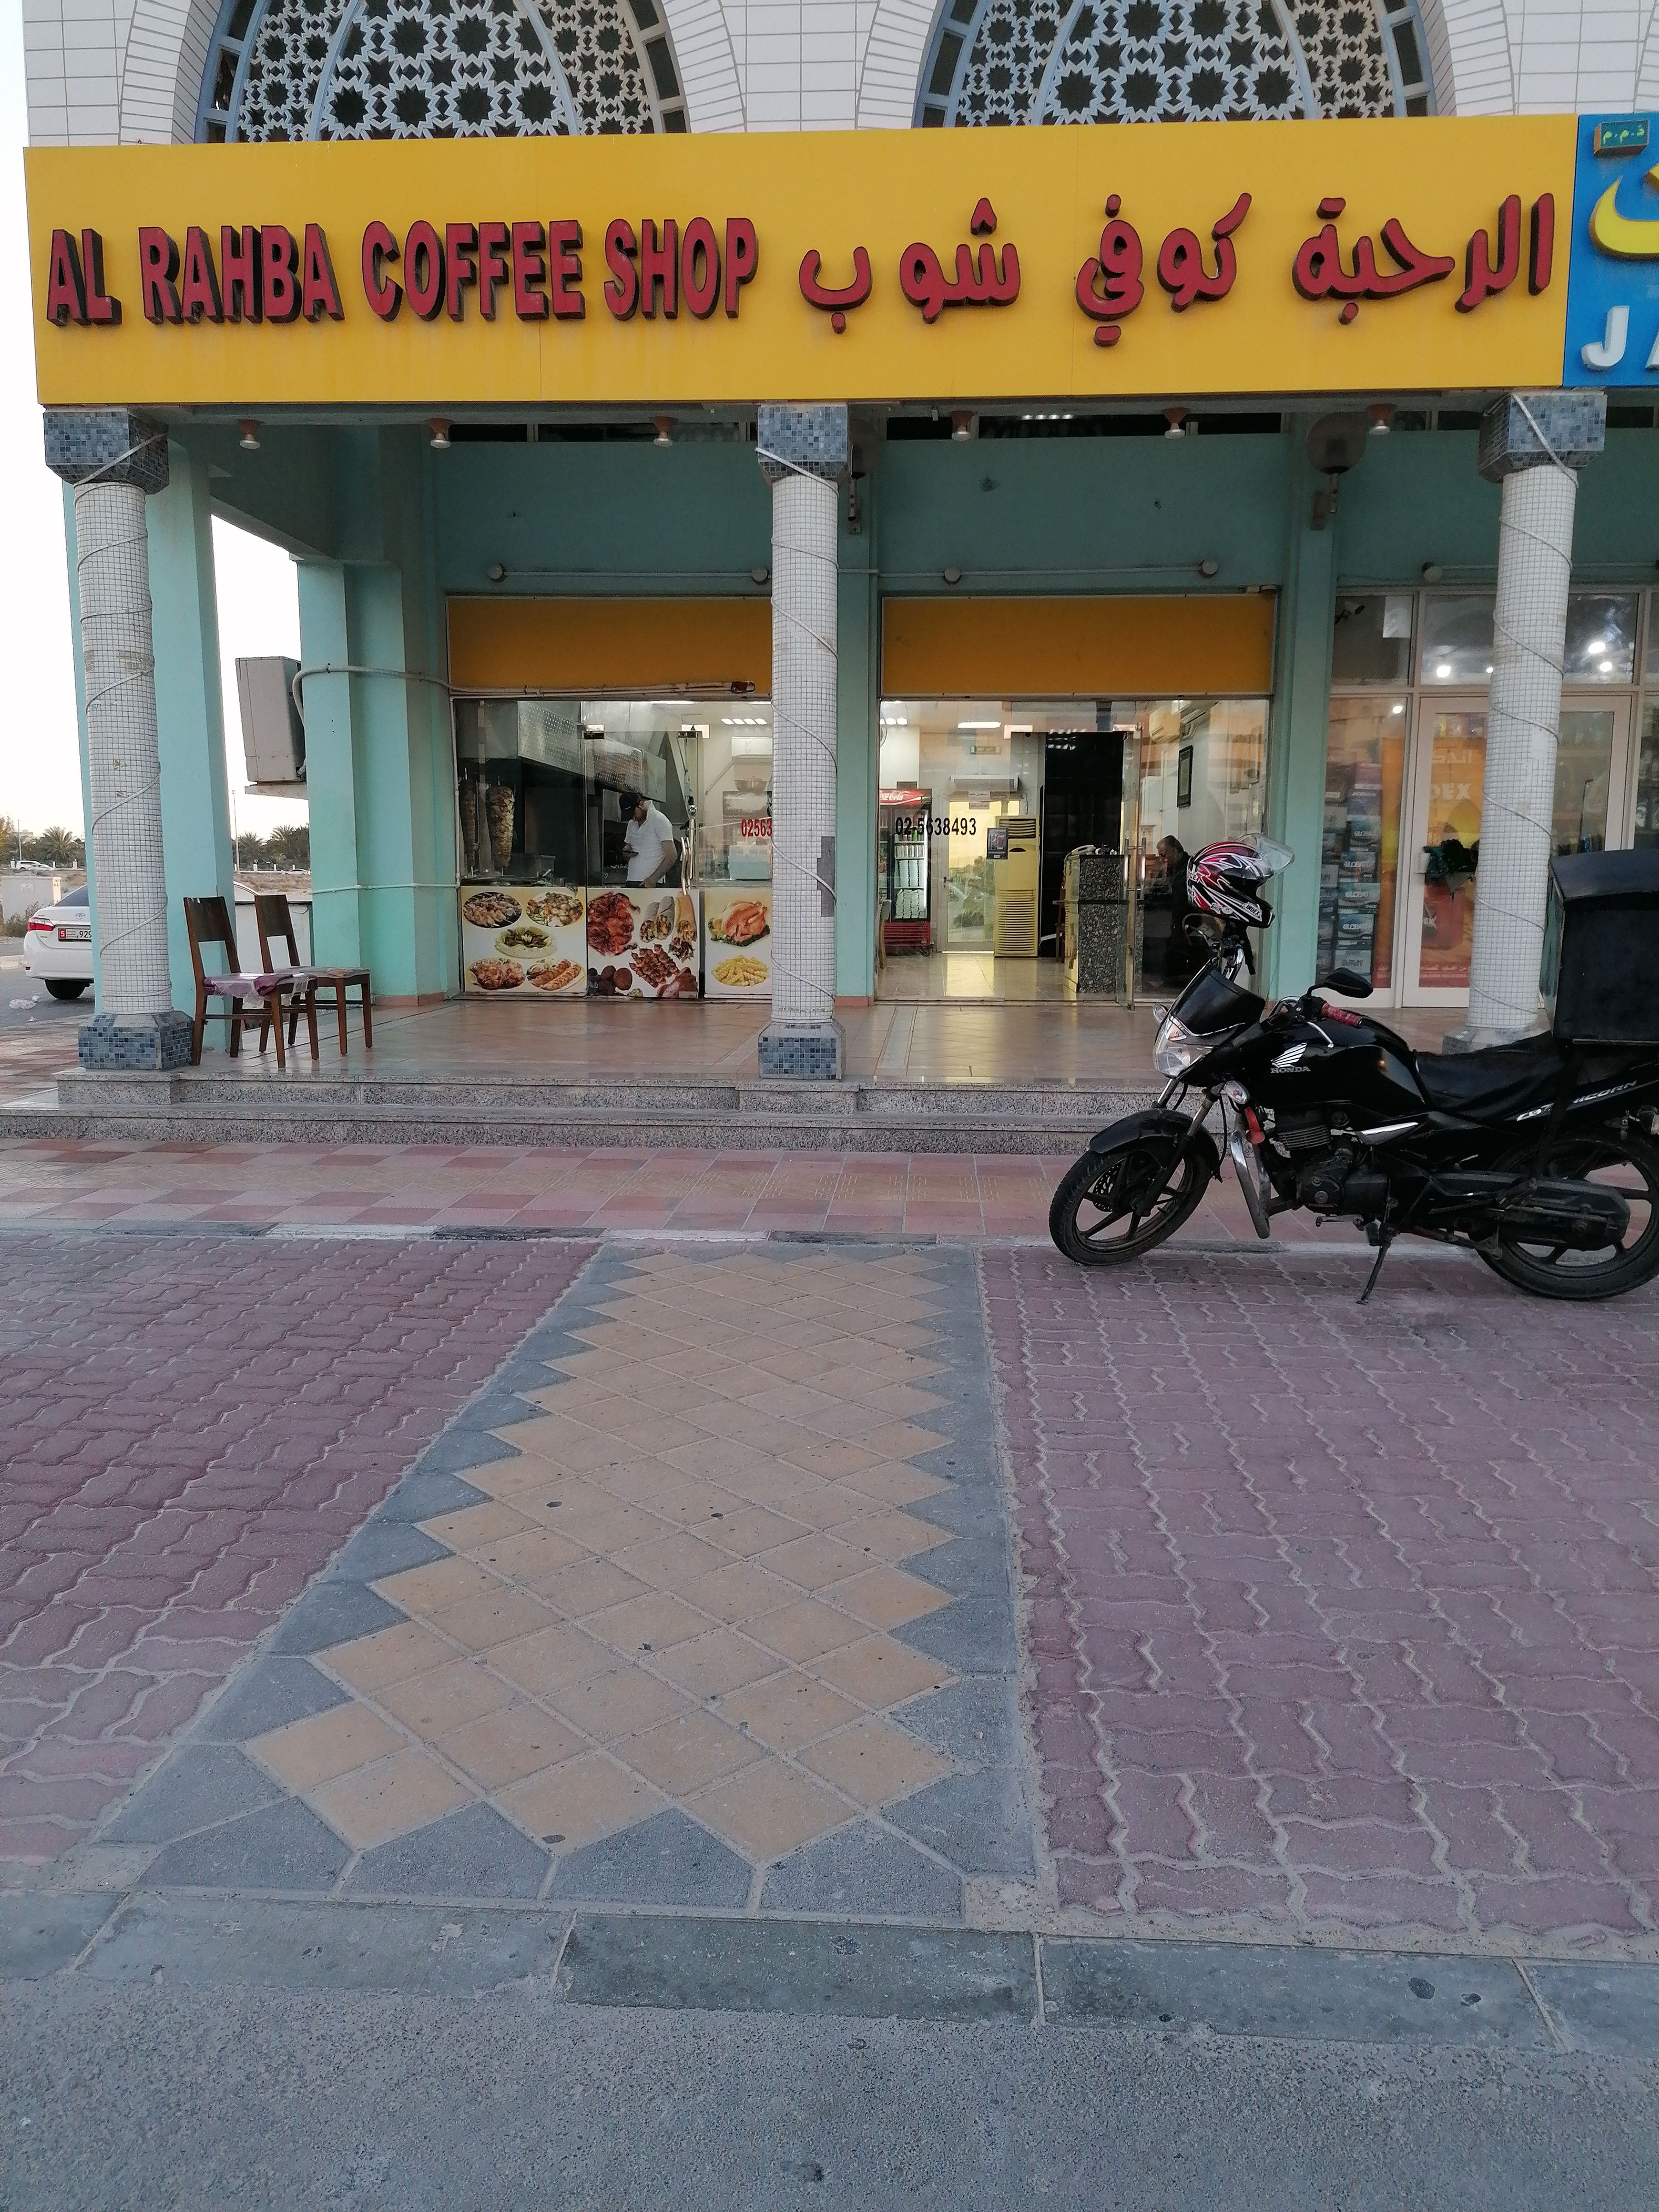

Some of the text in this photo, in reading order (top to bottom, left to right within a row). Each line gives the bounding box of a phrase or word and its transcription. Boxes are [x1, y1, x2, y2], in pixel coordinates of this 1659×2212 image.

[47, 217, 757, 327] AL RAHBA COFFEE SHOP
[799, 197, 1020, 334] شوب
[1076, 192, 1252, 347] كوفي
[1292, 192, 1554, 325] الرحبة
[741, 818, 772, 837] 02563
[895, 817, 976, 835] 02-5638493
[1245, 904, 1261, 915] INDEX
